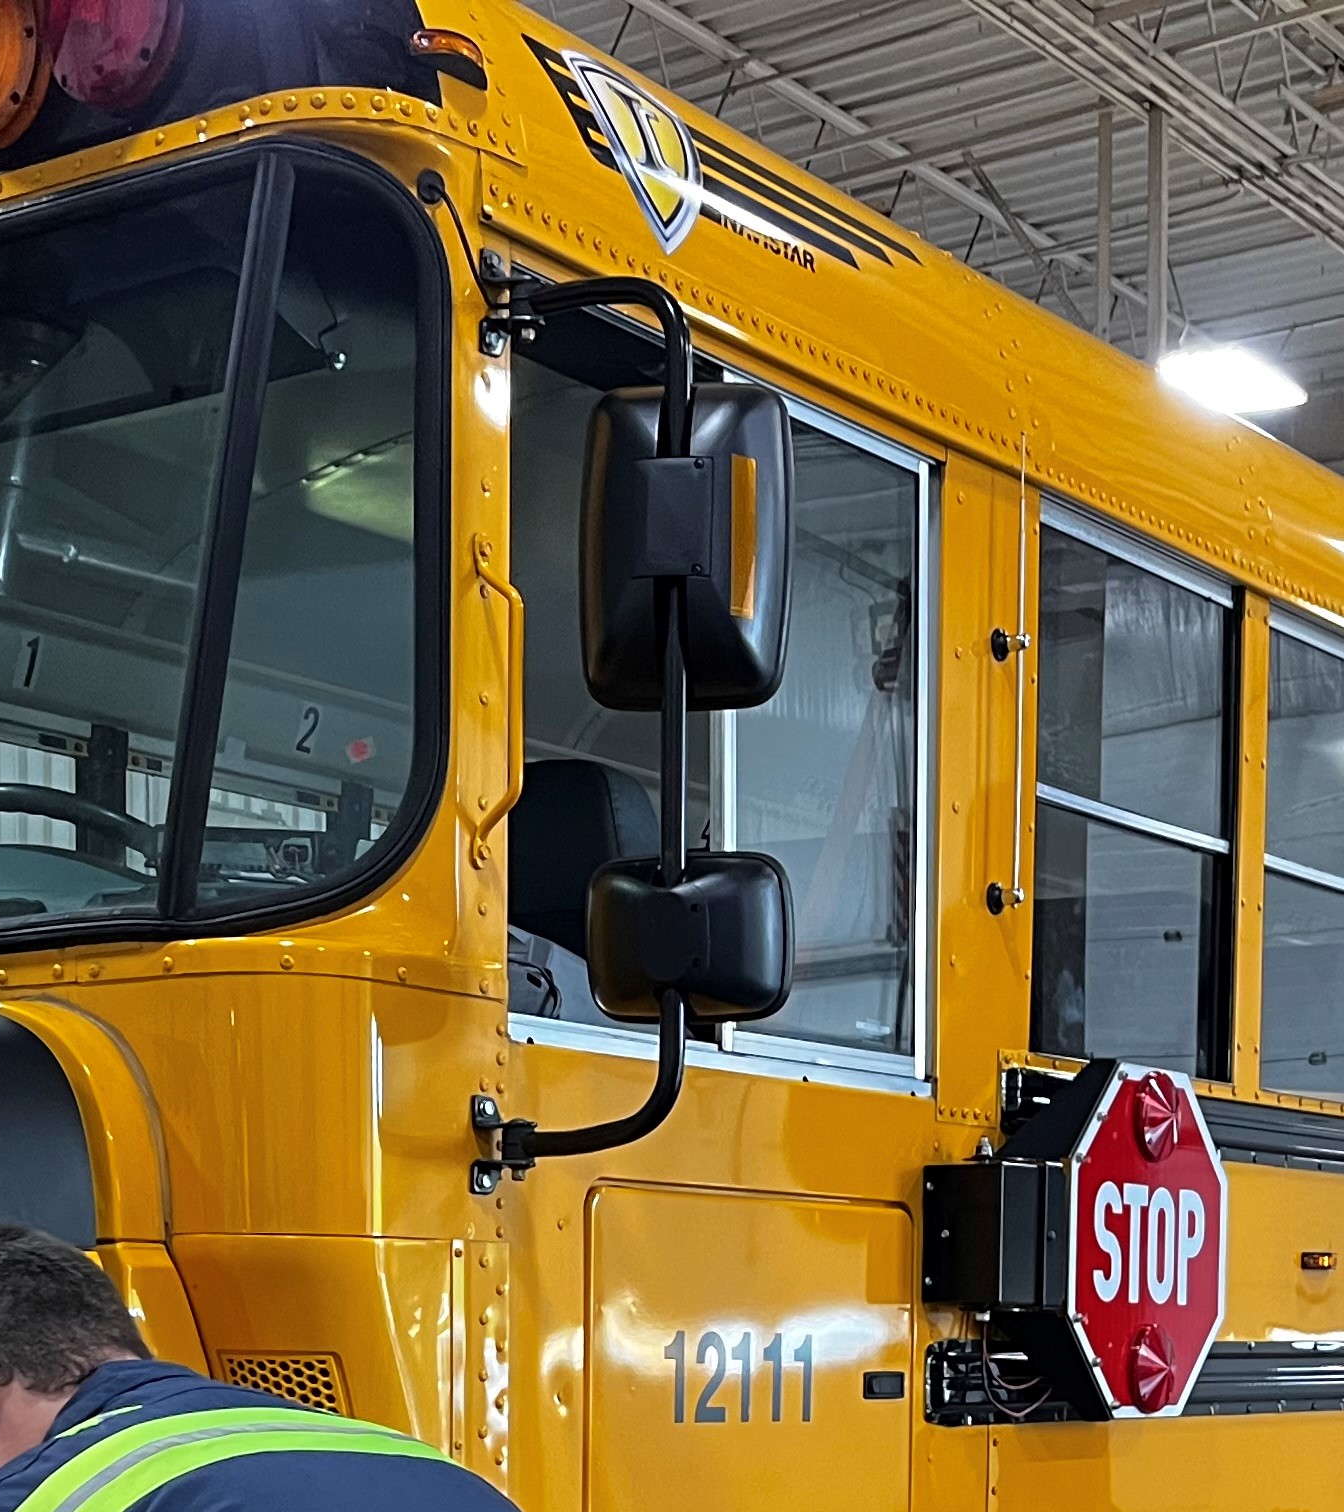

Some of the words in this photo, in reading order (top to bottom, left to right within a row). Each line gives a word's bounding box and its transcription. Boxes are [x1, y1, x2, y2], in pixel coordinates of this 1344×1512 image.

[23, 636, 40, 687] 1
[295, 706, 321, 755] 2
[1092, 1180, 1206, 1306] STOP
[663, 1329, 814, 1424] 12111
